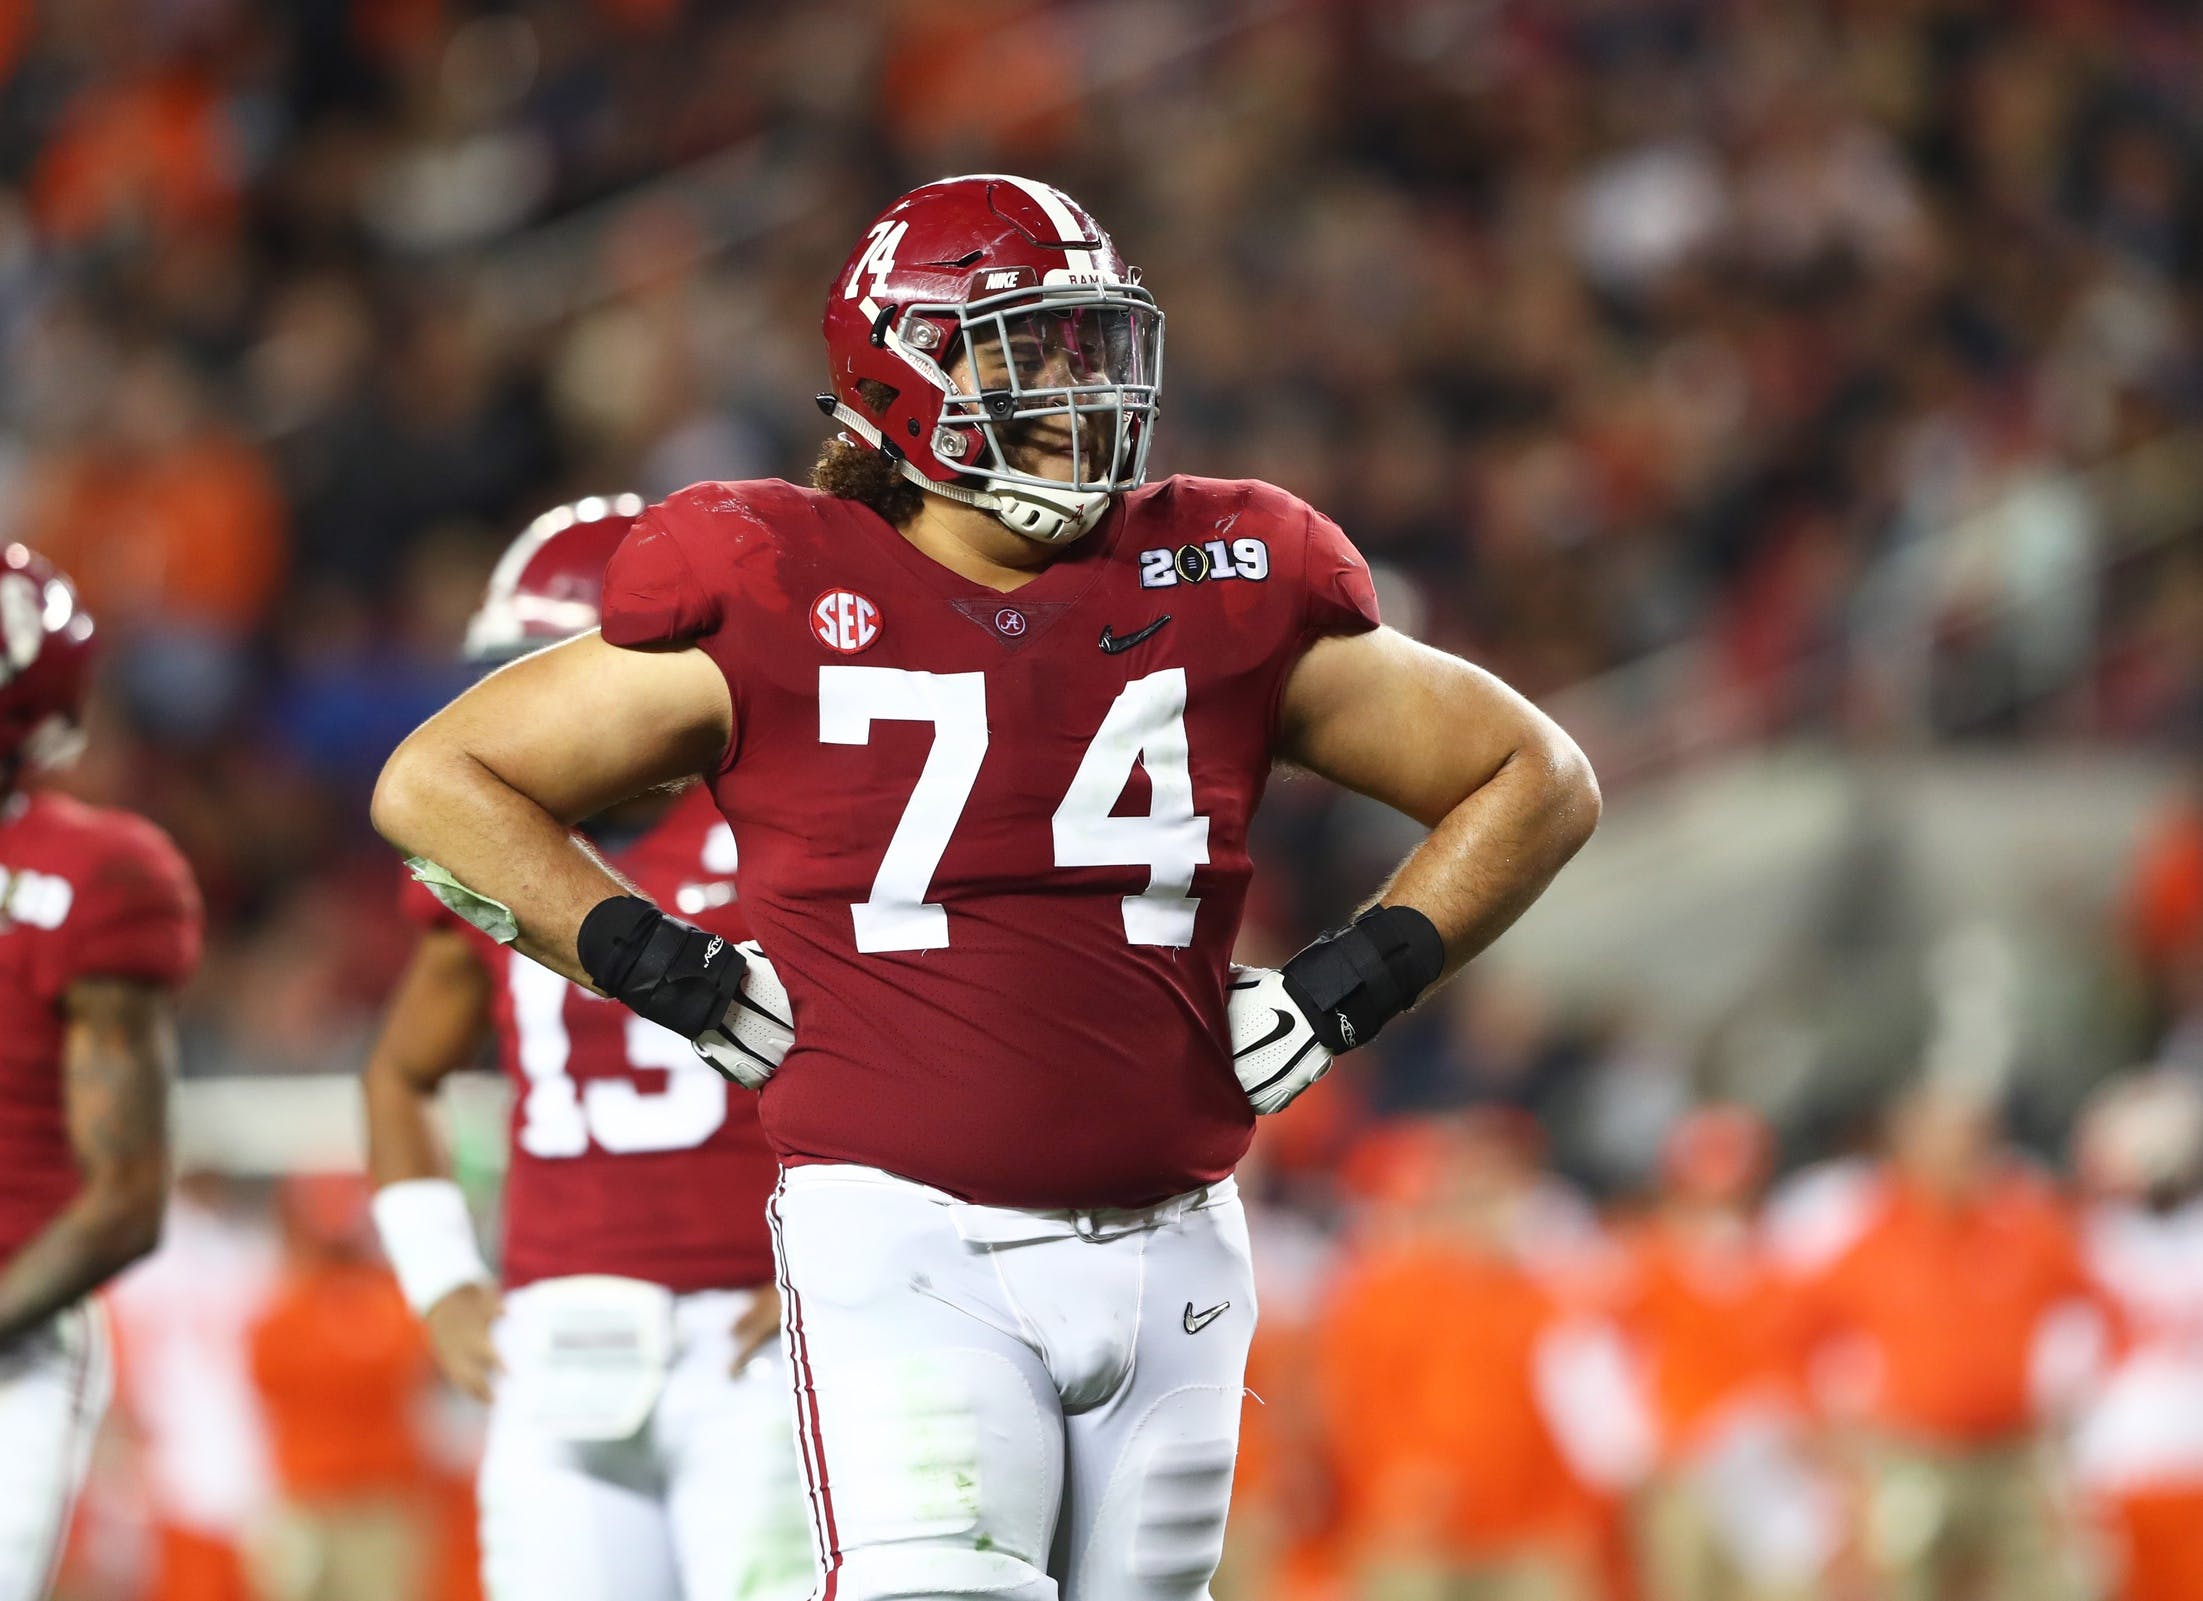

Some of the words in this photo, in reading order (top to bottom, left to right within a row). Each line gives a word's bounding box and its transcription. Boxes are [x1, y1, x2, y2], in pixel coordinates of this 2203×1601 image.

[844, 219, 909, 300] 74
[985, 271, 1020, 290] NIKE
[815, 591, 878, 651] SEC
[818, 665, 1211, 954] 74
